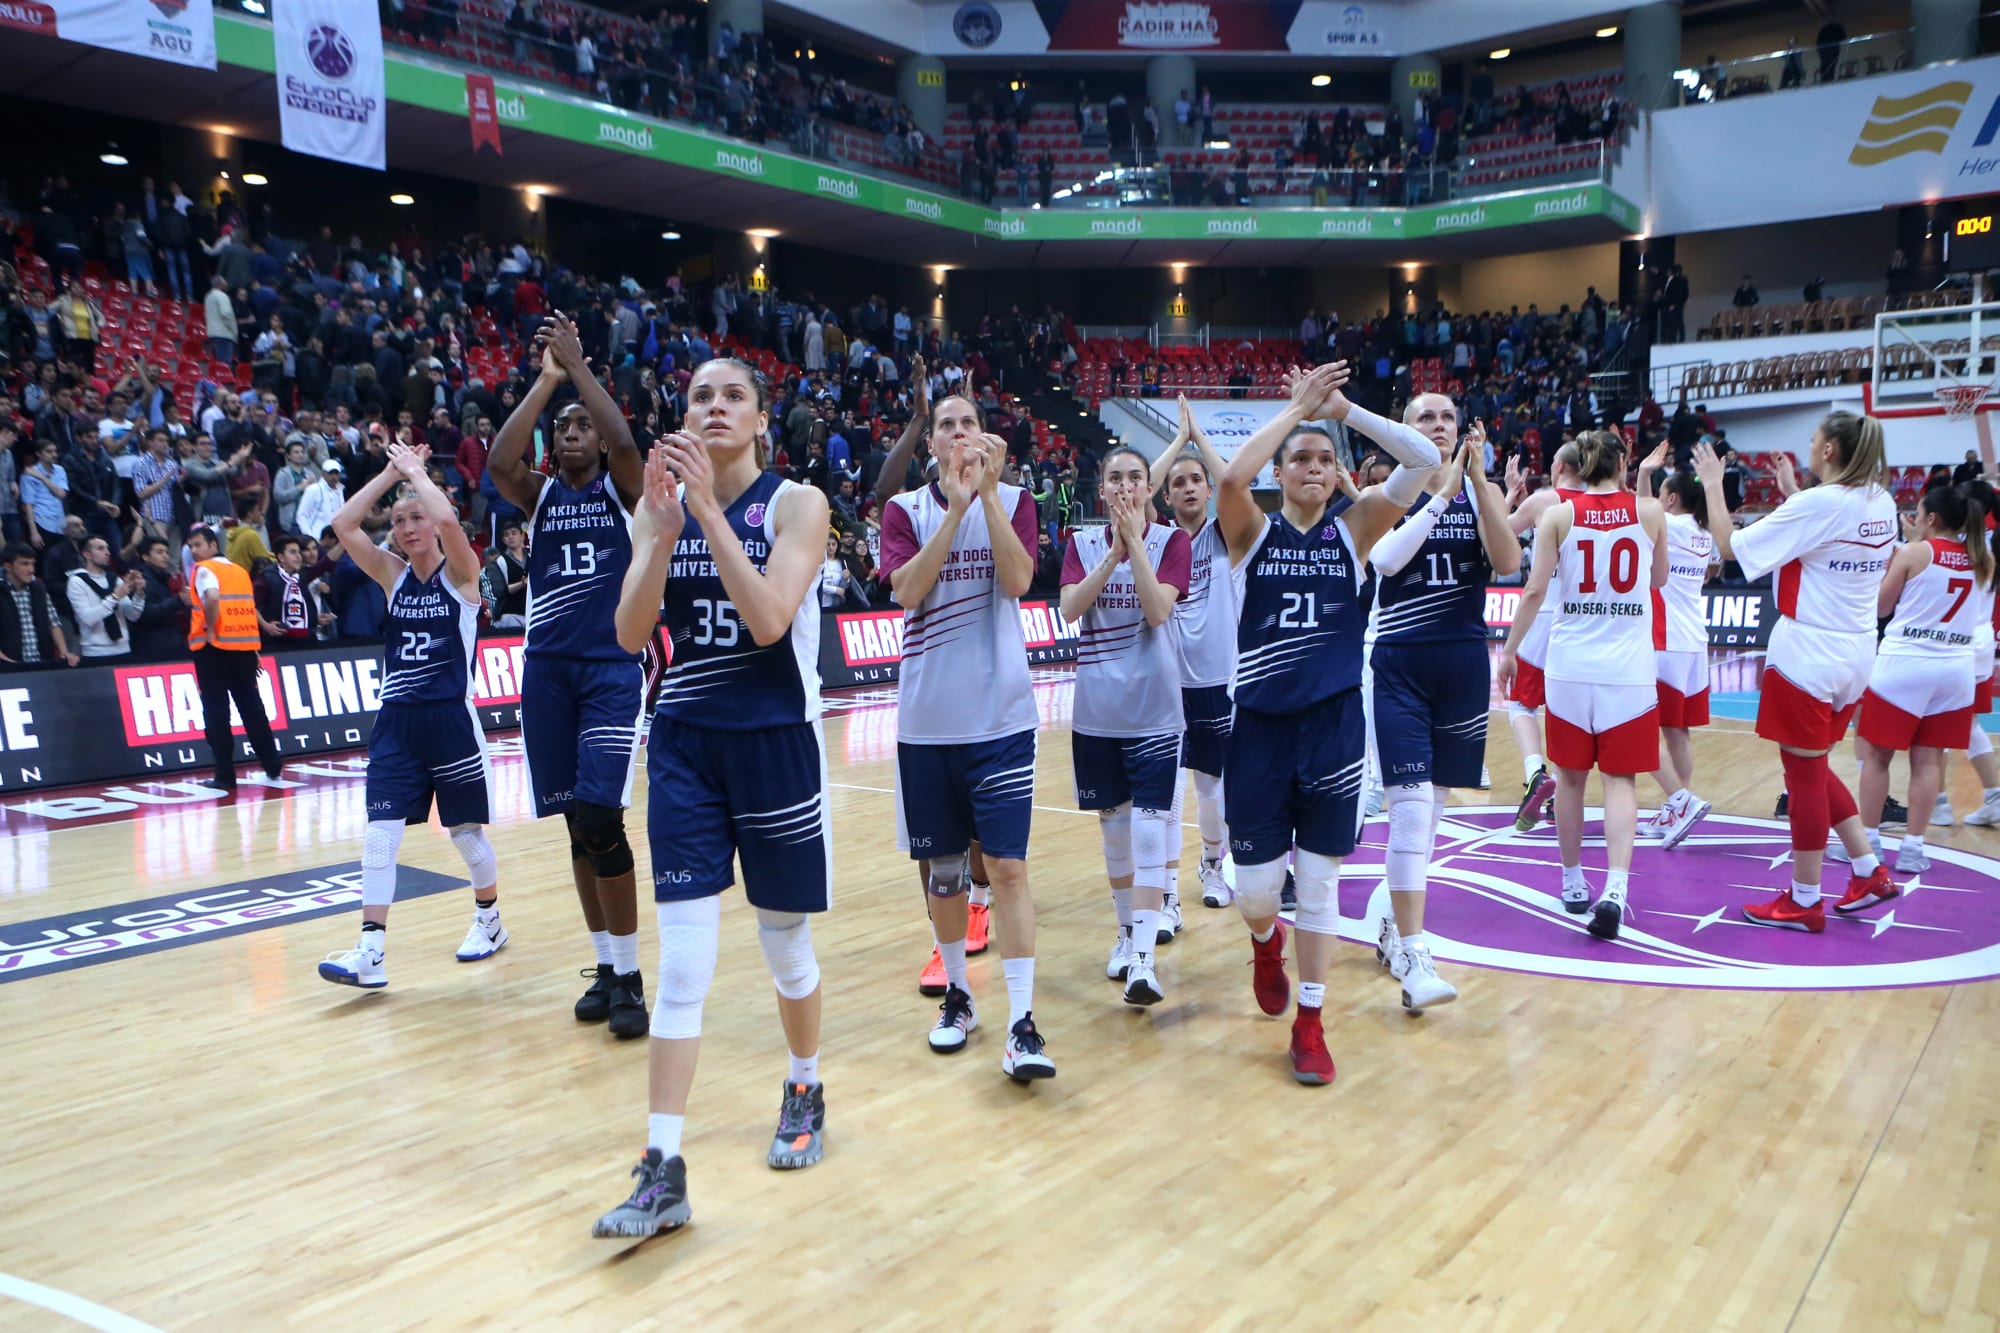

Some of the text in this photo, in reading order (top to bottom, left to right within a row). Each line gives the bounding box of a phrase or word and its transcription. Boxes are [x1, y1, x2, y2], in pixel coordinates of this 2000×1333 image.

[1181, 18, 1218, 33] HAS
[150, 33, 193, 55] AGU
[600, 125, 653, 149] mondi
[717, 151, 763, 174] mondi
[818, 176, 859, 196] mondi
[906, 199, 942, 218] mondi
[1534, 188, 1589, 217] mondi
[984, 215, 1025, 233] mondi
[1091, 214, 1142, 233] mondi
[1207, 214, 1258, 233] mondi
[1322, 214, 1372, 233] mondi
[1436, 204, 1487, 229] mondi
[1168, 303, 1189, 315] 110
[1443, 512, 1473, 525] DOĞU
[1583, 507, 1631, 525] JELENA
[561, 541, 596, 577] 13
[1426, 553, 1458, 586] 11
[1577, 537, 1639, 594] 10
[1279, 592, 1319, 628] 21
[1939, 577, 1974, 623] 7
[692, 598, 738, 647] 35
[400, 631, 431, 661] 22
[280, 657, 384, 721] LINE
